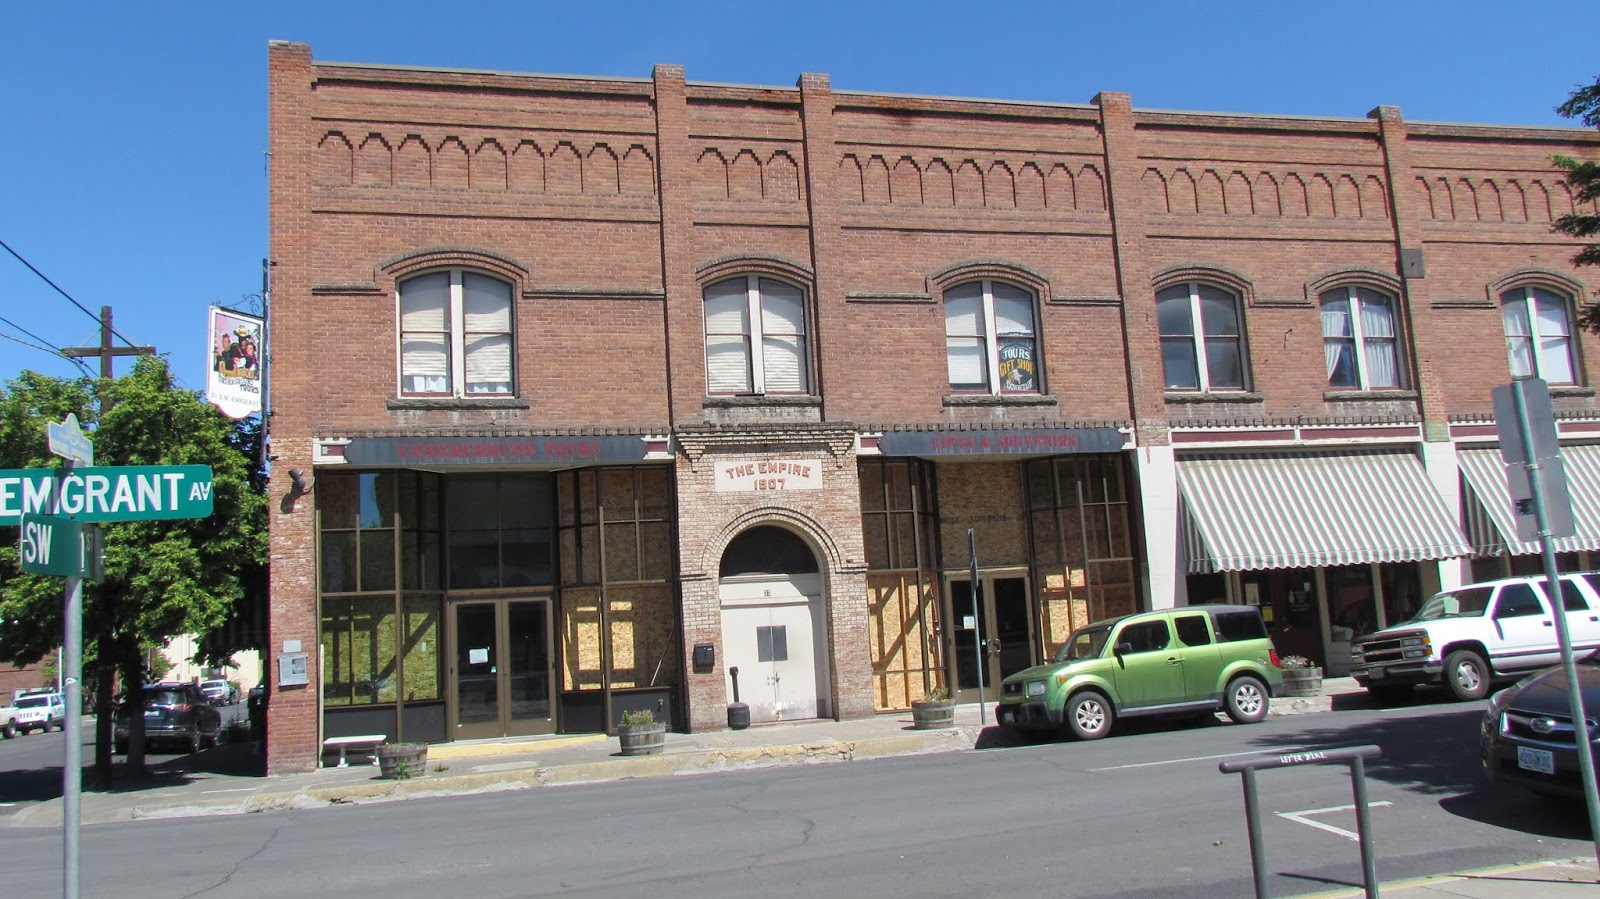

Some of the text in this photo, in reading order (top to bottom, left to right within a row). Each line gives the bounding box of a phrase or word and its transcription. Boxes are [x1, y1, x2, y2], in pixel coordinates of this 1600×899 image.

[1003, 348, 1031, 360] TOURS
[1000, 360, 1015, 377] GIFT
[725, 462, 811, 479] THE EMPIRE
[753, 478, 786, 490] 1907
[0, 473, 212, 517] EMIGRANT AV
[24, 521, 53, 565] SW
